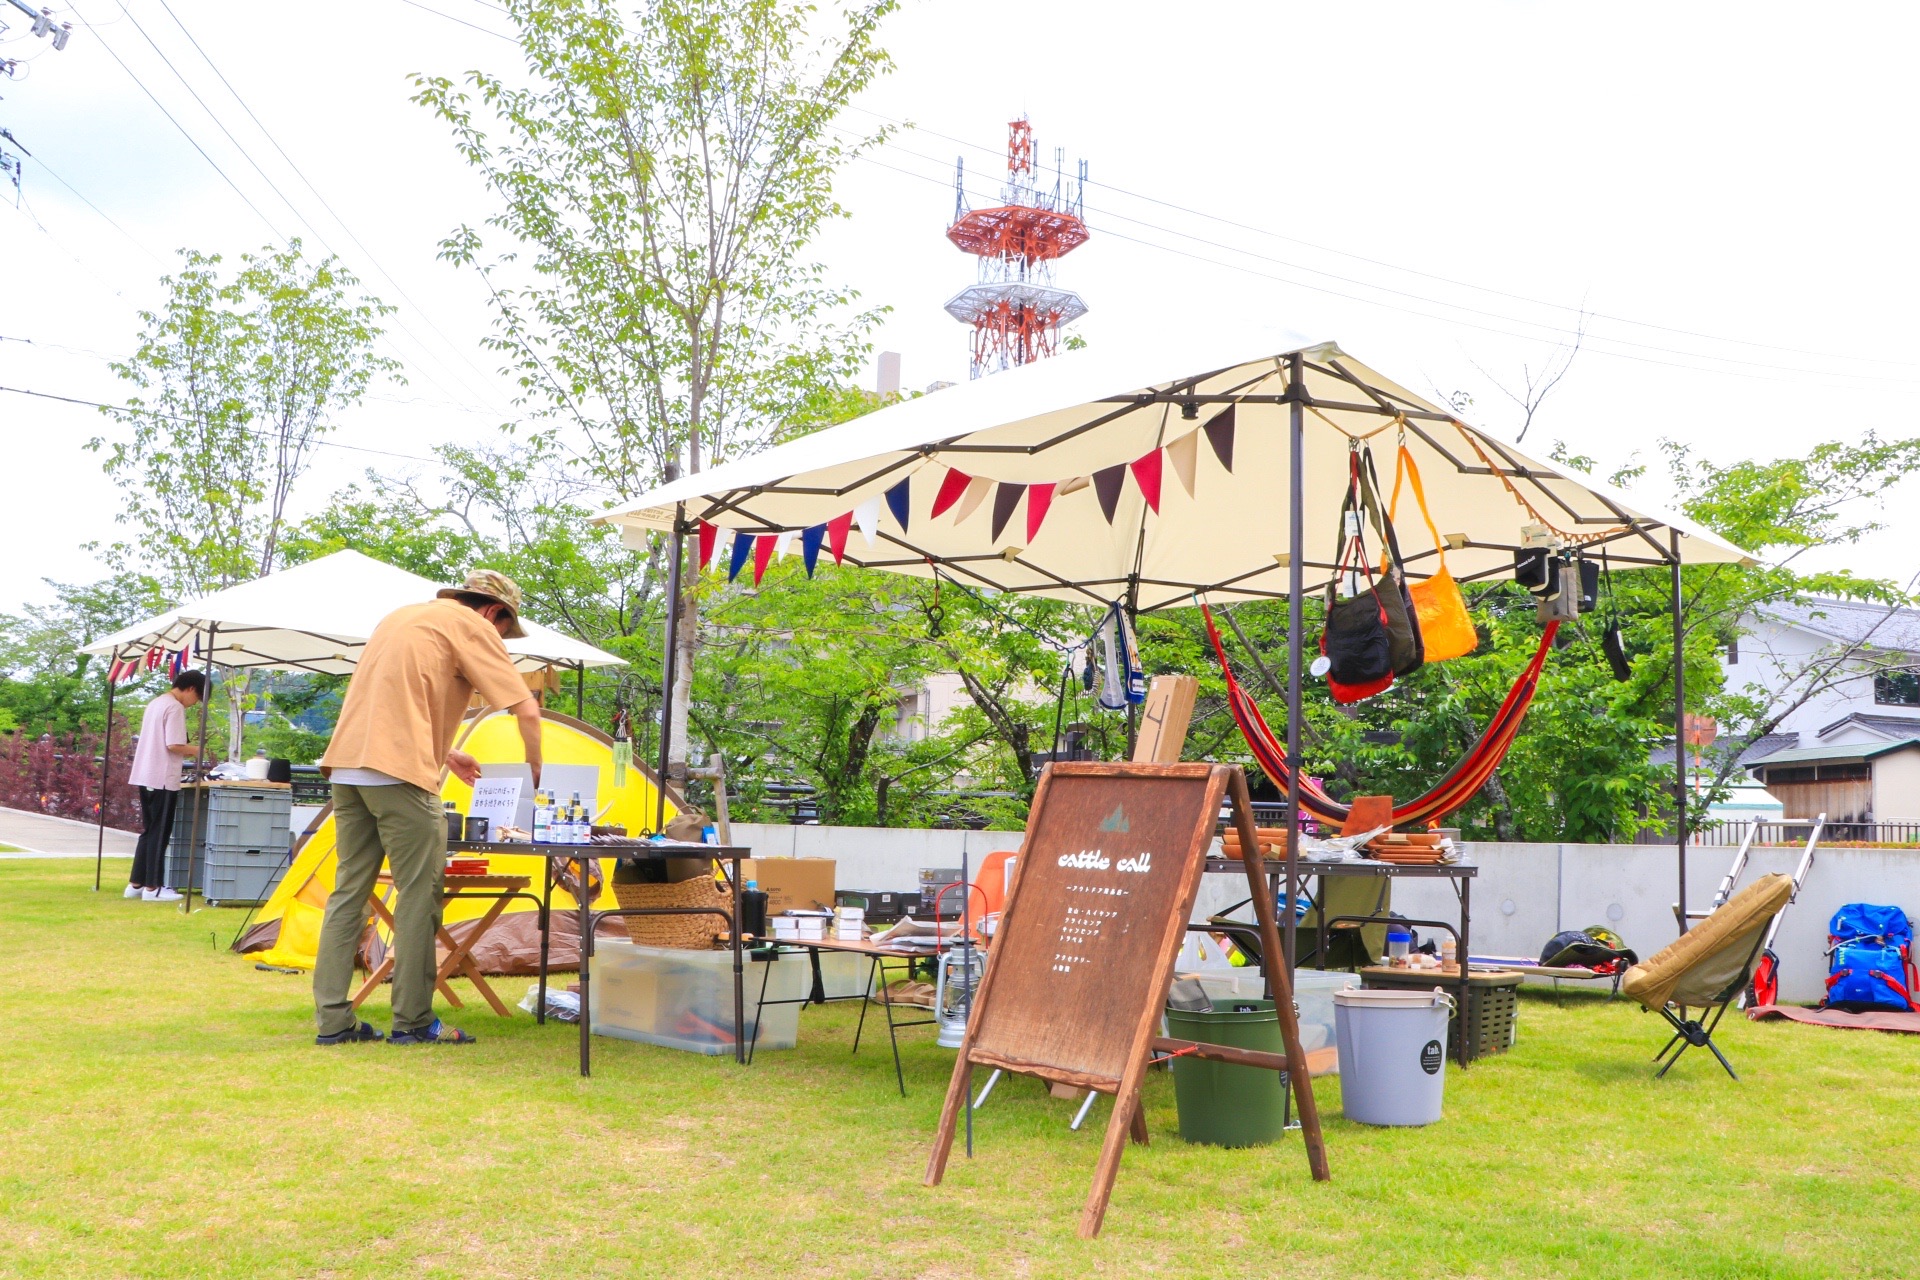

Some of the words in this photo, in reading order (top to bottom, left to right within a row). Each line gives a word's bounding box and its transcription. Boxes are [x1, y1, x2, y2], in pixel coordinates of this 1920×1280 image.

[1058, 849, 1111, 870] cattle
[1116, 852, 1151, 873] call
[1064, 917, 1102, 927] クライミング
[1062, 926, 1100, 936] キャンピング
[1059, 935, 1083, 944] トラベル
[1054, 953, 1091, 963] アクセサリー
